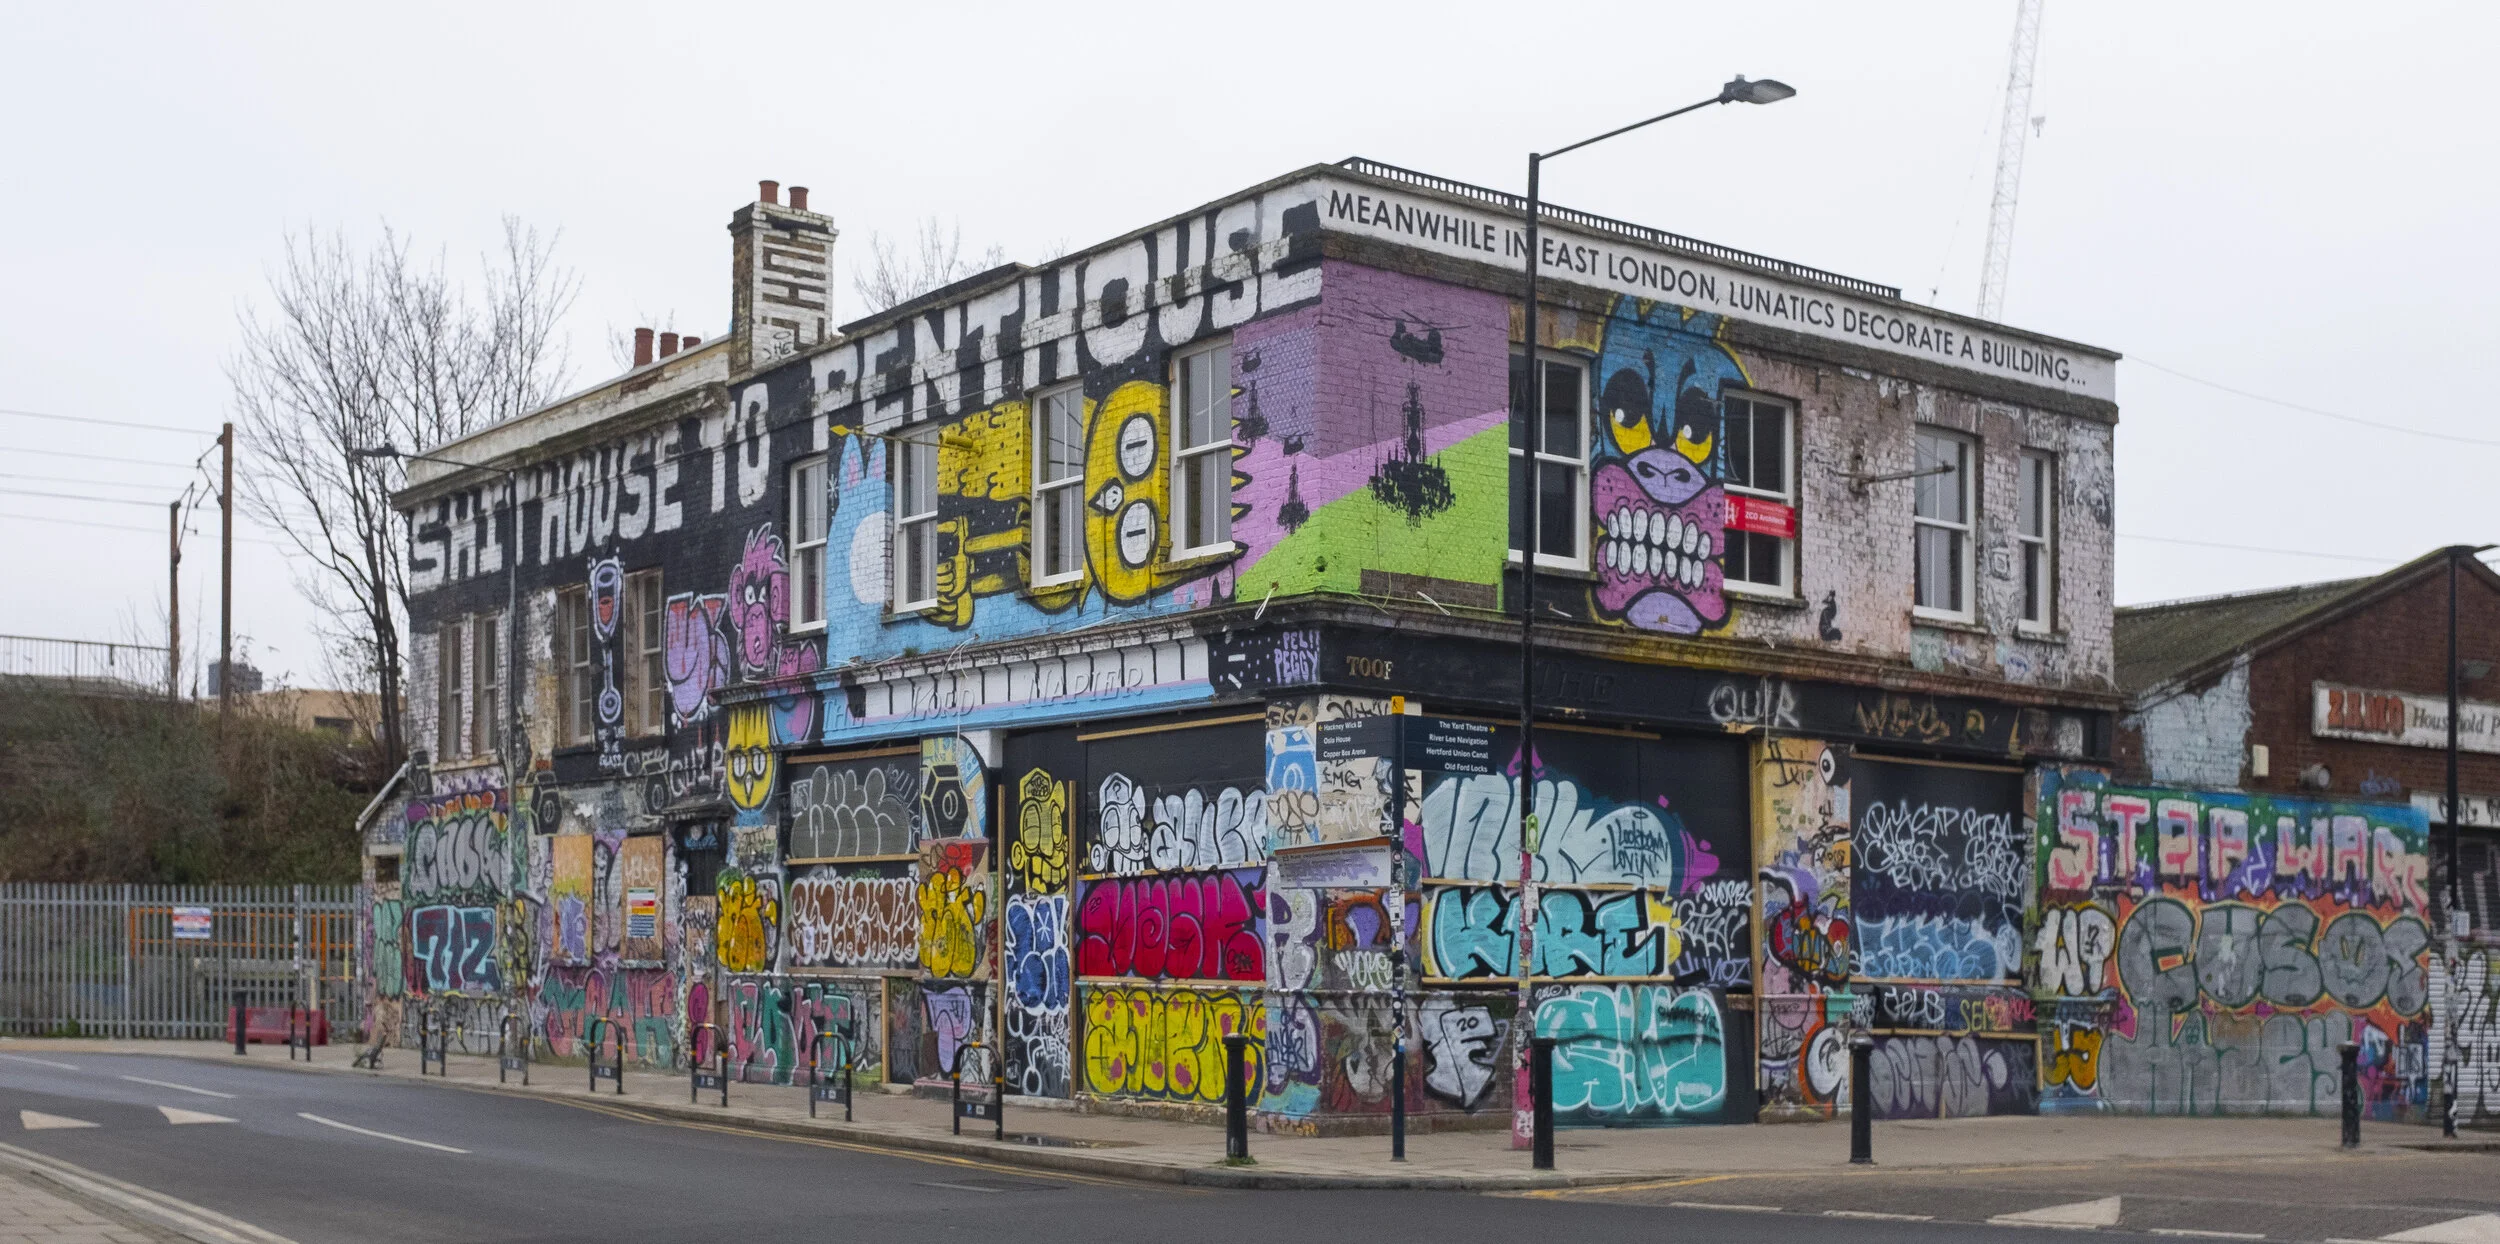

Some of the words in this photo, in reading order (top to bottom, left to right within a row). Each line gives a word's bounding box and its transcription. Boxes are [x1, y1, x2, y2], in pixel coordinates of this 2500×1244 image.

[1328, 190, 1495, 253] MEANWHILE
[1505, 228, 1532, 261] IN
[1542, 237, 1600, 277] EAST
[1608, 253, 1721, 304] LONDON,
[1729, 280, 1836, 329] LUNATICS
[1843, 307, 1954, 357] DECORATE
[1960, 337, 1974, 360] A
[1982, 340, 2087, 387] BUILDING...
[699, 383, 770, 515] TO
[810, 178, 1323, 451] PENTHOUSE
[1274, 648, 1319, 685] PEGGY
[903, 683, 976, 723] LORD
[1023, 666, 1145, 708] NAPIER
[1439, 720, 1451, 729] The
[1451, 721, 1465, 731] Yard
[1465, 723, 1489, 732] Theatre
[2413, 706, 2485, 733] Houshold
[1323, 723, 1344, 732] Hackney
[1345, 721, 1357, 730] Wick
[1429, 733, 1444, 742] River
[1445, 735, 1456, 743] Lee
[1457, 736, 1489, 746] Navigation
[1323, 750, 1341, 759] Copper
[1341, 749, 1351, 757] Box
[1351, 748, 1366, 757] Arena
[1426, 747, 1452, 757] Hertford
[1453, 749, 1471, 758] Union
[1471, 751, 1489, 759] Canal
[1444, 762, 1455, 771] Old
[1455, 763, 1469, 772] Ford
[1470, 764, 1488, 773] Locks
